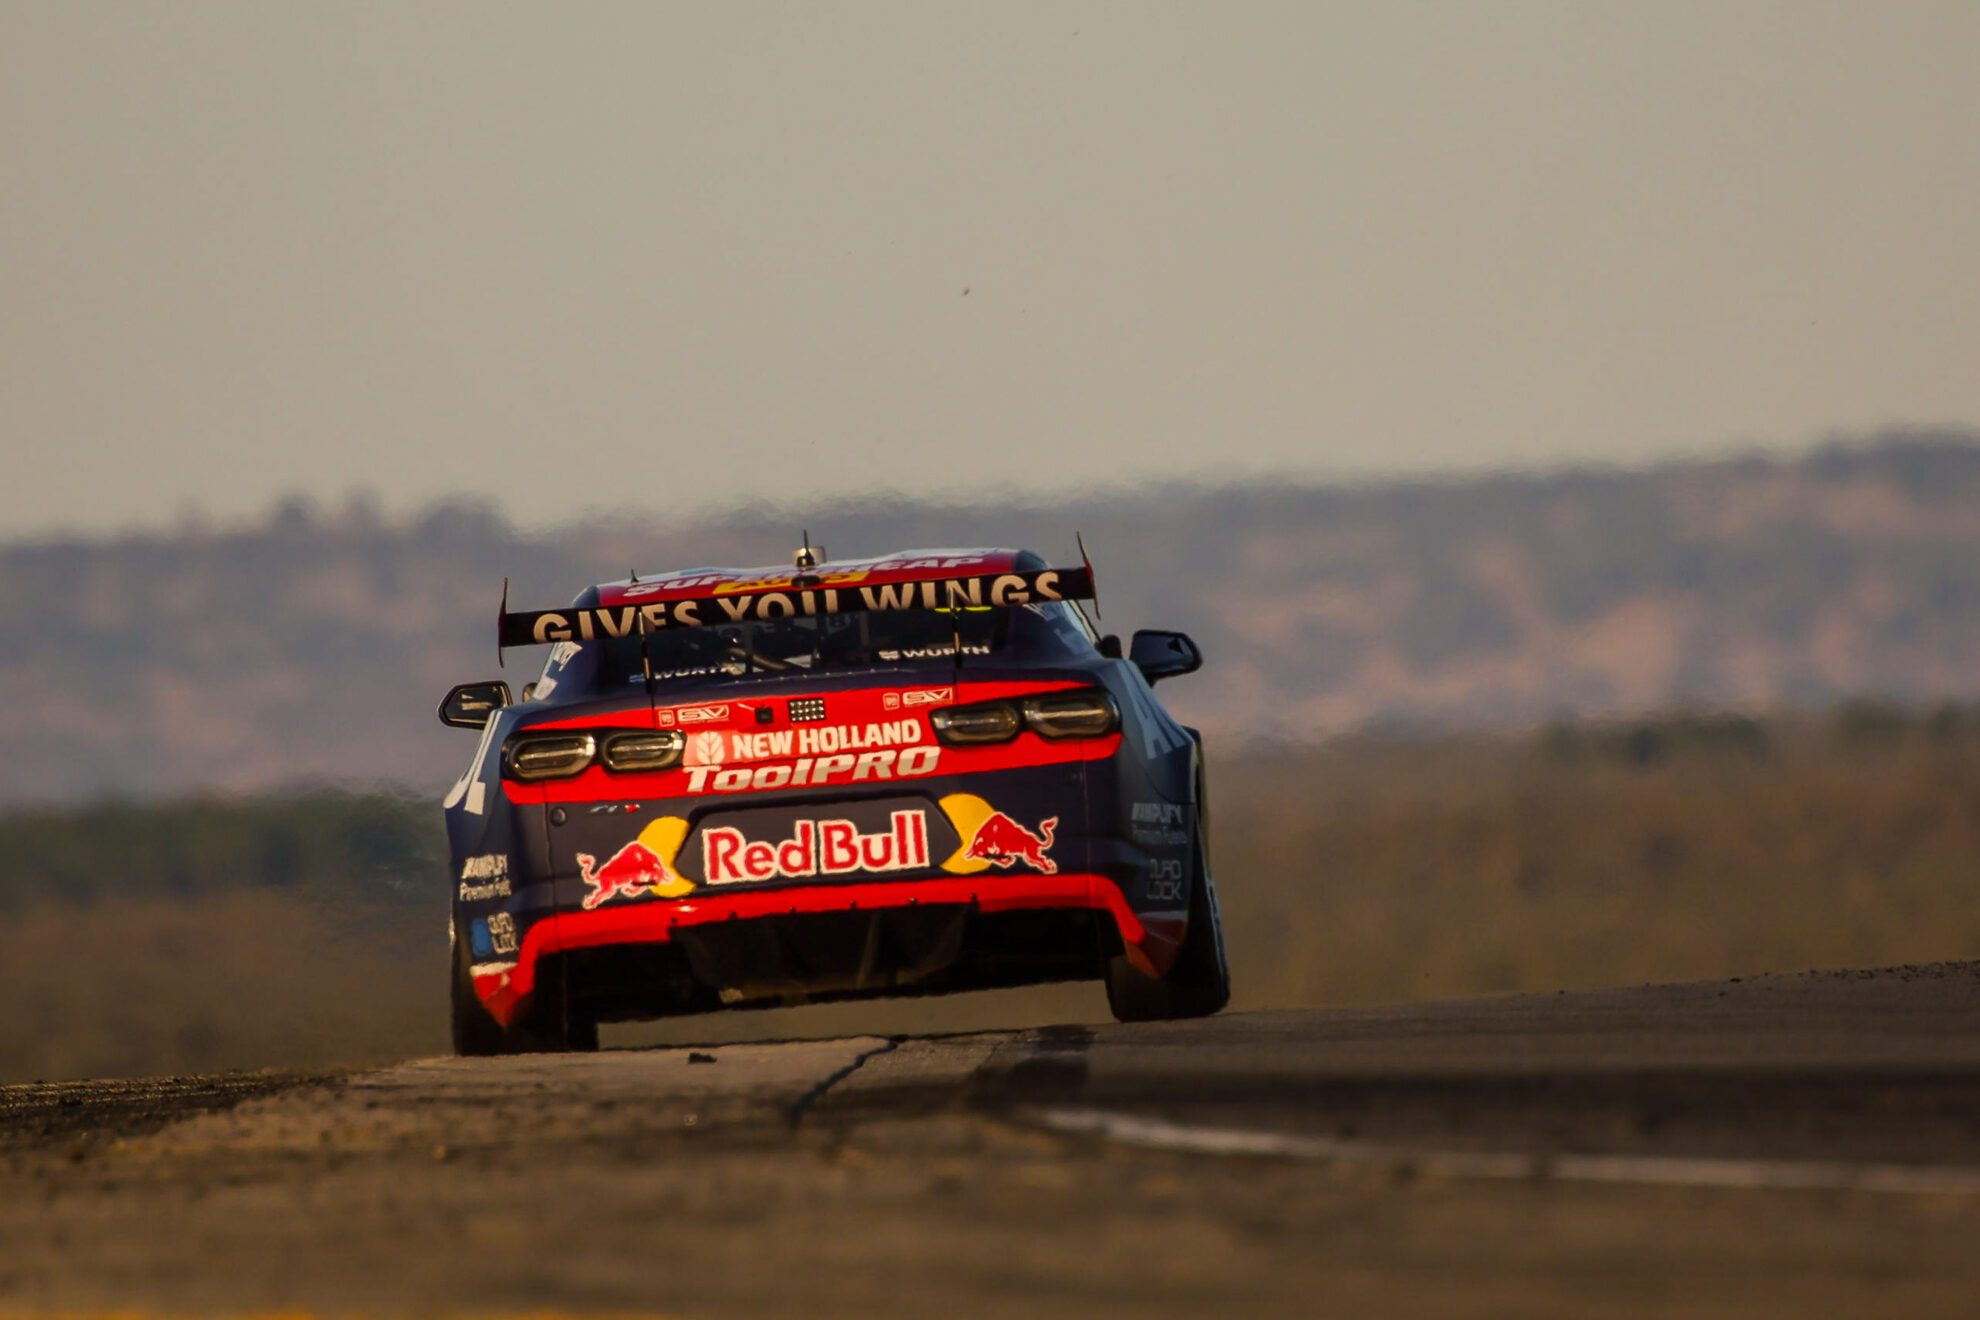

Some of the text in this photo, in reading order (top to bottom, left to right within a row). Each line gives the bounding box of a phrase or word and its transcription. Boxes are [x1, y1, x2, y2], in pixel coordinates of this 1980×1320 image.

[532, 600, 703, 645] GIVES
[859, 570, 1063, 612] WINGS
[732, 718, 922, 759] NEW HOLLAND
[701, 809, 930, 885] Red Bull
